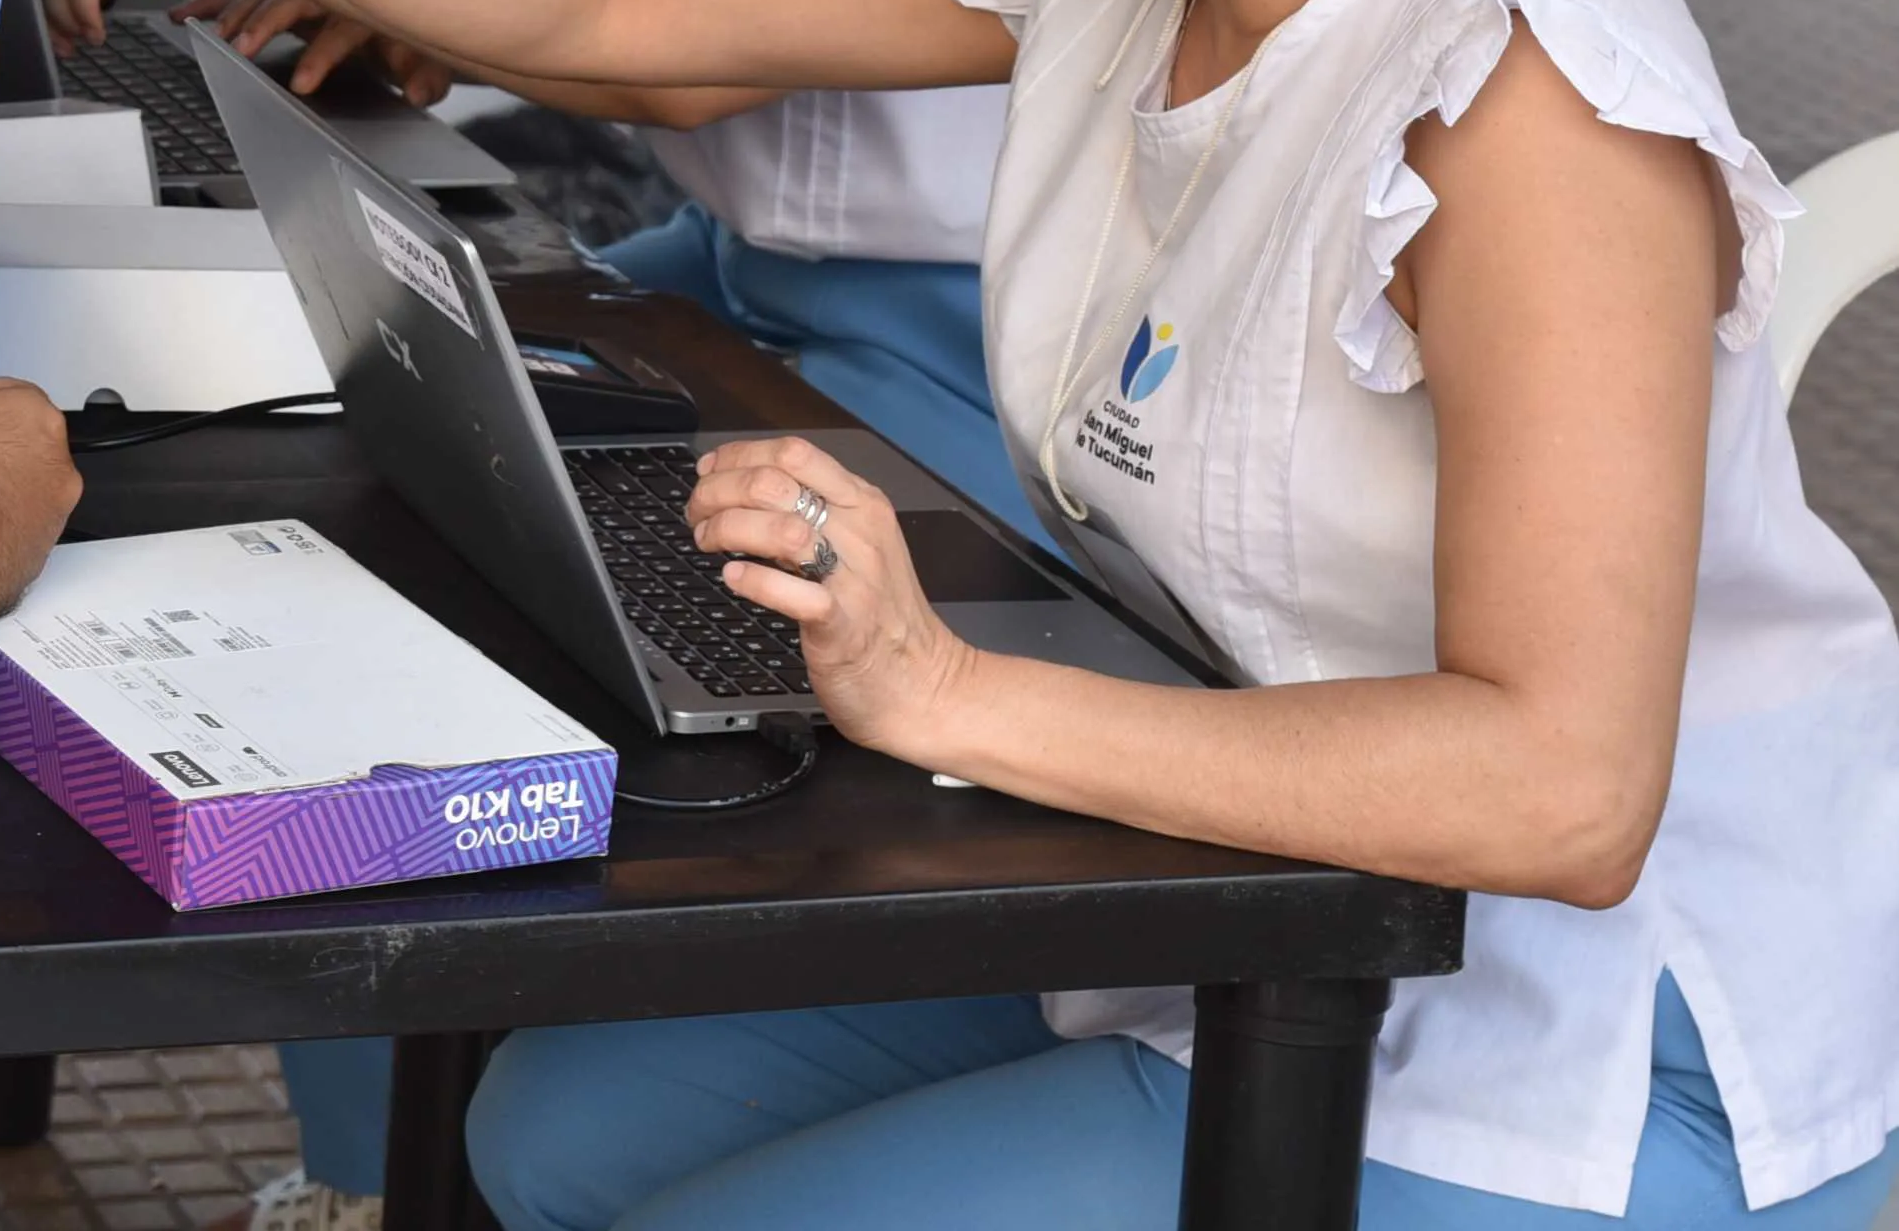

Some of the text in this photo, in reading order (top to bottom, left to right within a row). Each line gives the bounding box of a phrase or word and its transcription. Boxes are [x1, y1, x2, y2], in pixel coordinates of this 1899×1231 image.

[1103, 400, 1141, 429] CIUDAD
[1088, 435, 1156, 485] Tucumán
[1103, 422, 1154, 462] Miguel
[162, 754, 211, 785] Lenovo
[444, 779, 584, 825] Tab K10
[455, 814, 581, 851] Lenovo
